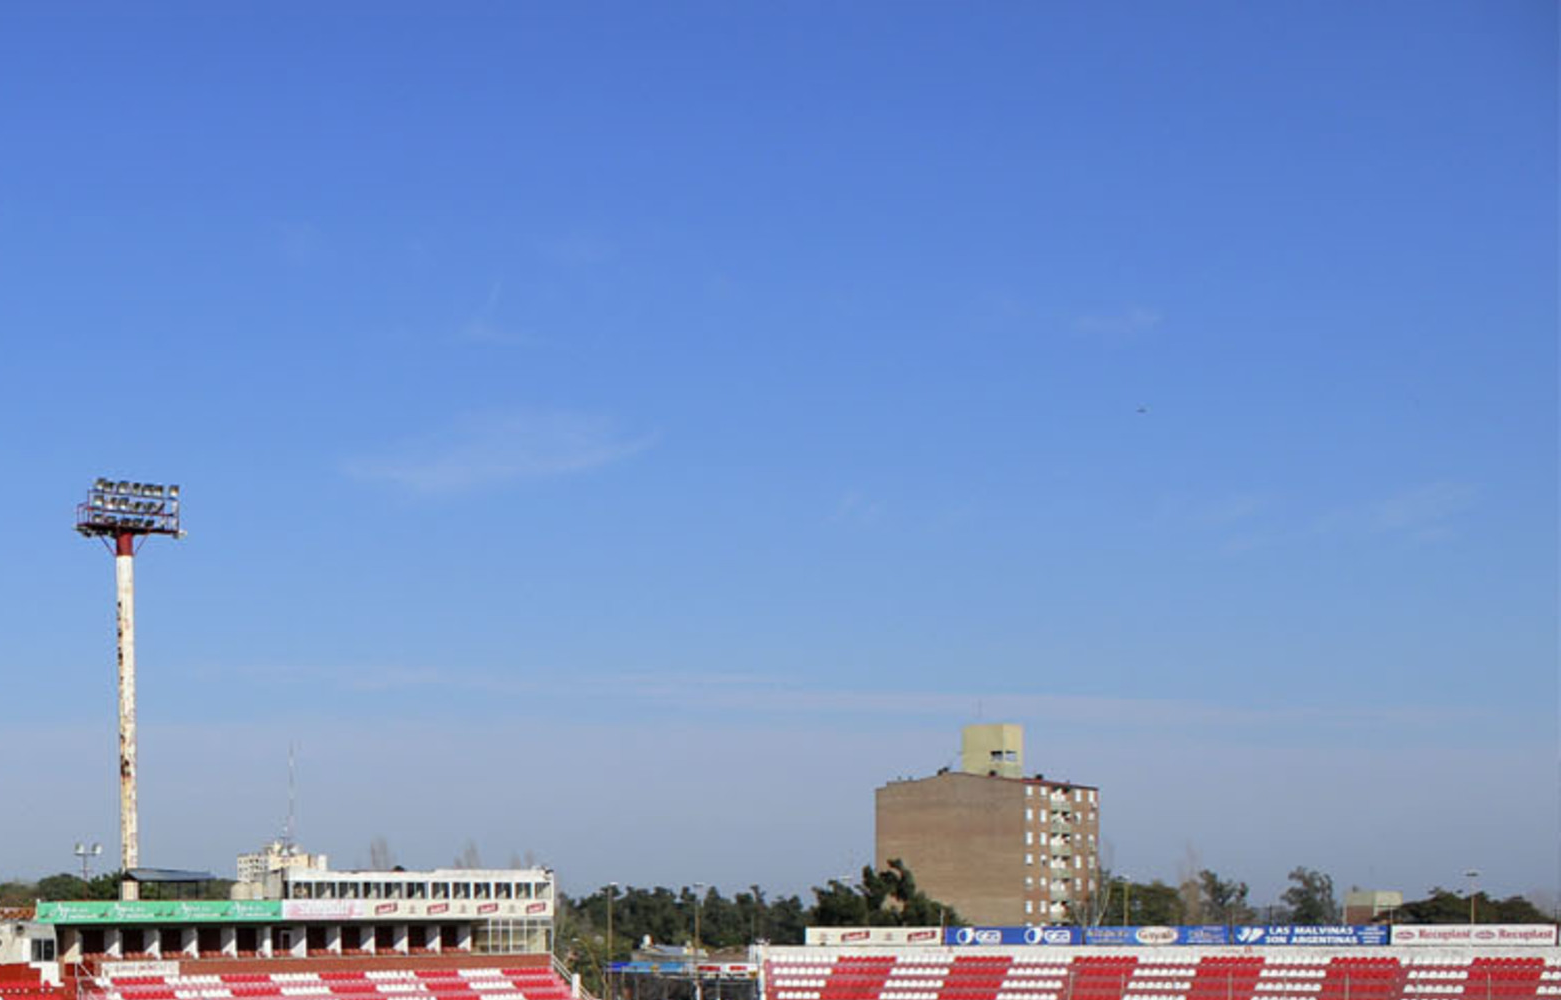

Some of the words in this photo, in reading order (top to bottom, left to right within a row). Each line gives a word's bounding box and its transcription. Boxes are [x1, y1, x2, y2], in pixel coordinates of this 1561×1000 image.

[1269, 926, 1290, 935] LAS
[1294, 926, 1354, 935] MALVINAS
[1265, 936, 1288, 944] SON
[1290, 936, 1358, 944] ARGENTINAS
